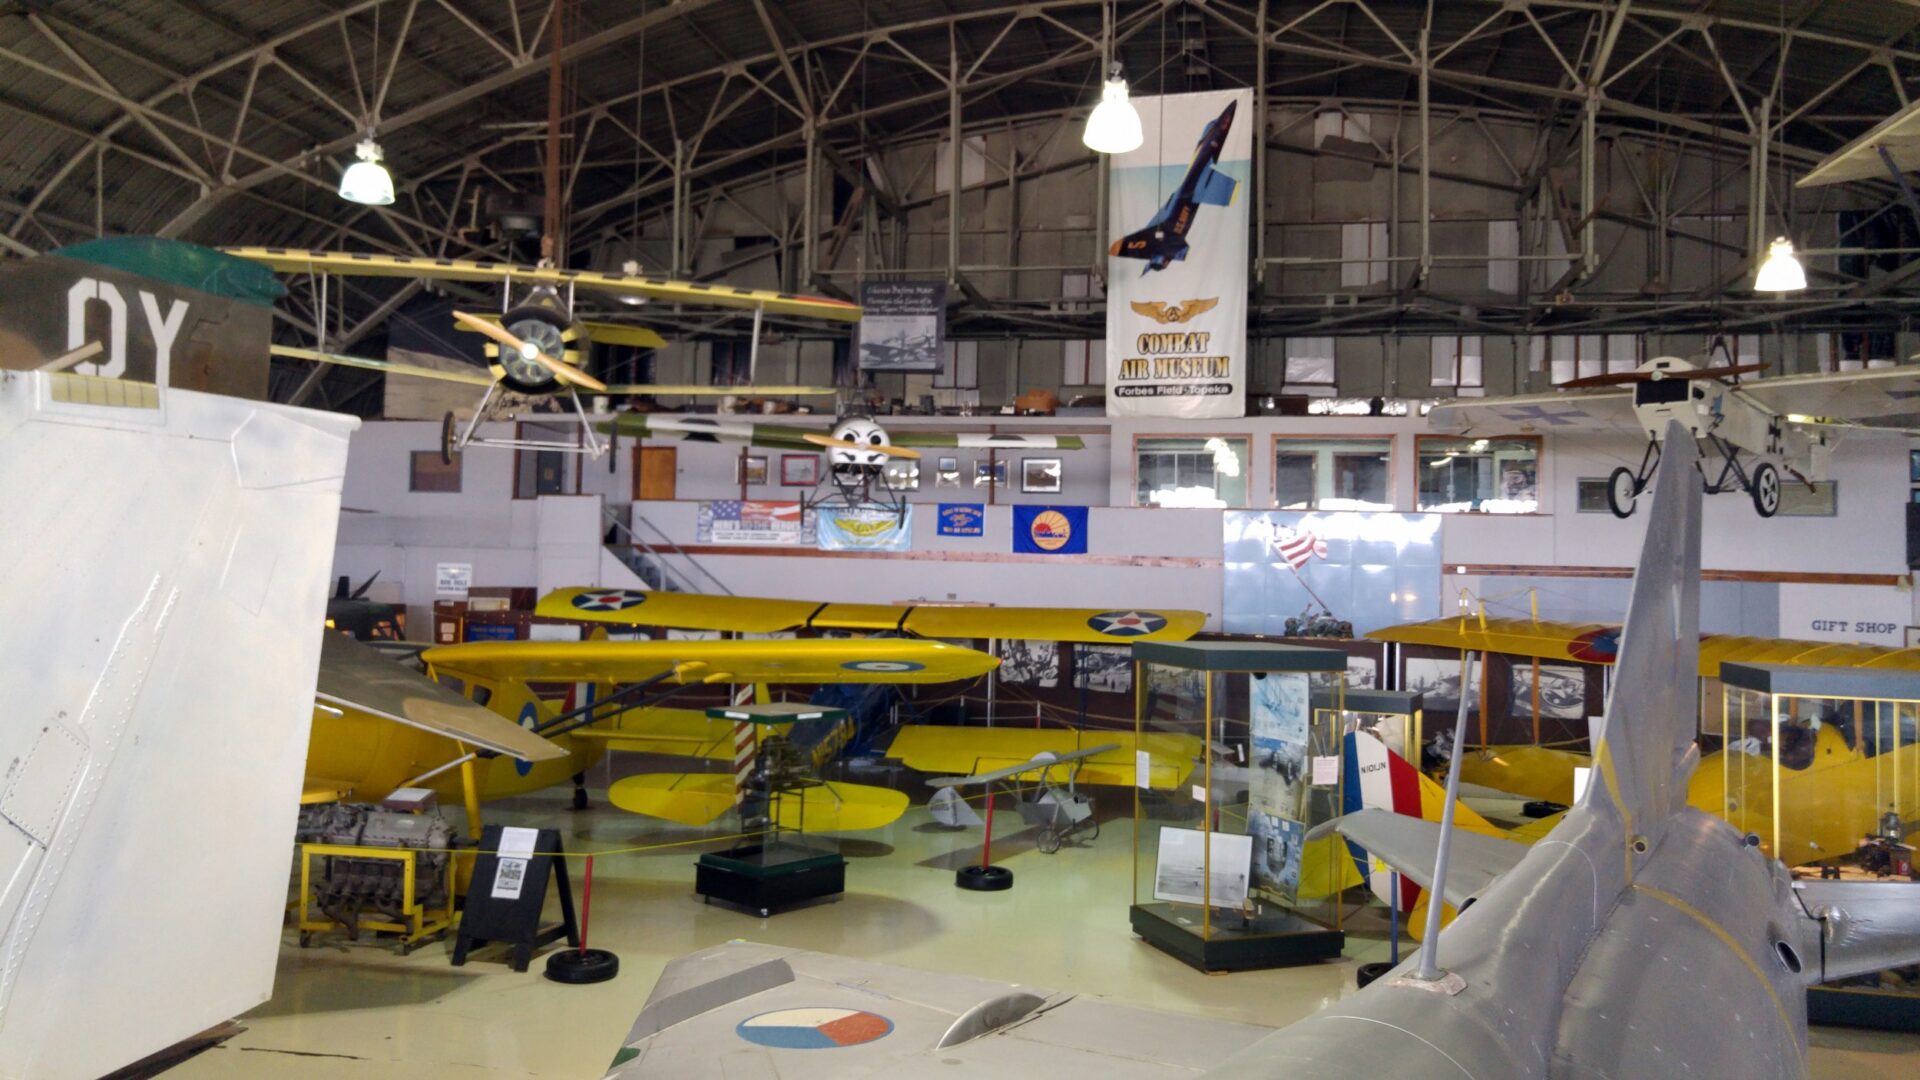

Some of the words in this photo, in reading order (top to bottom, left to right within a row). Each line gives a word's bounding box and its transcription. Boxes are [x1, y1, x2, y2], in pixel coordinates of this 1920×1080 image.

[1137, 332, 1210, 355] COMBAT
[1118, 358, 1149, 380] AIR
[1154, 356, 1230, 379] MUSEUM
[1118, 386, 1154, 396] Forbes
[1157, 385, 1183, 395] Field
[1190, 384, 1229, 396] Topeka
[1811, 620, 1848, 632] GIFT
[1855, 622, 1897, 634] SHOP
